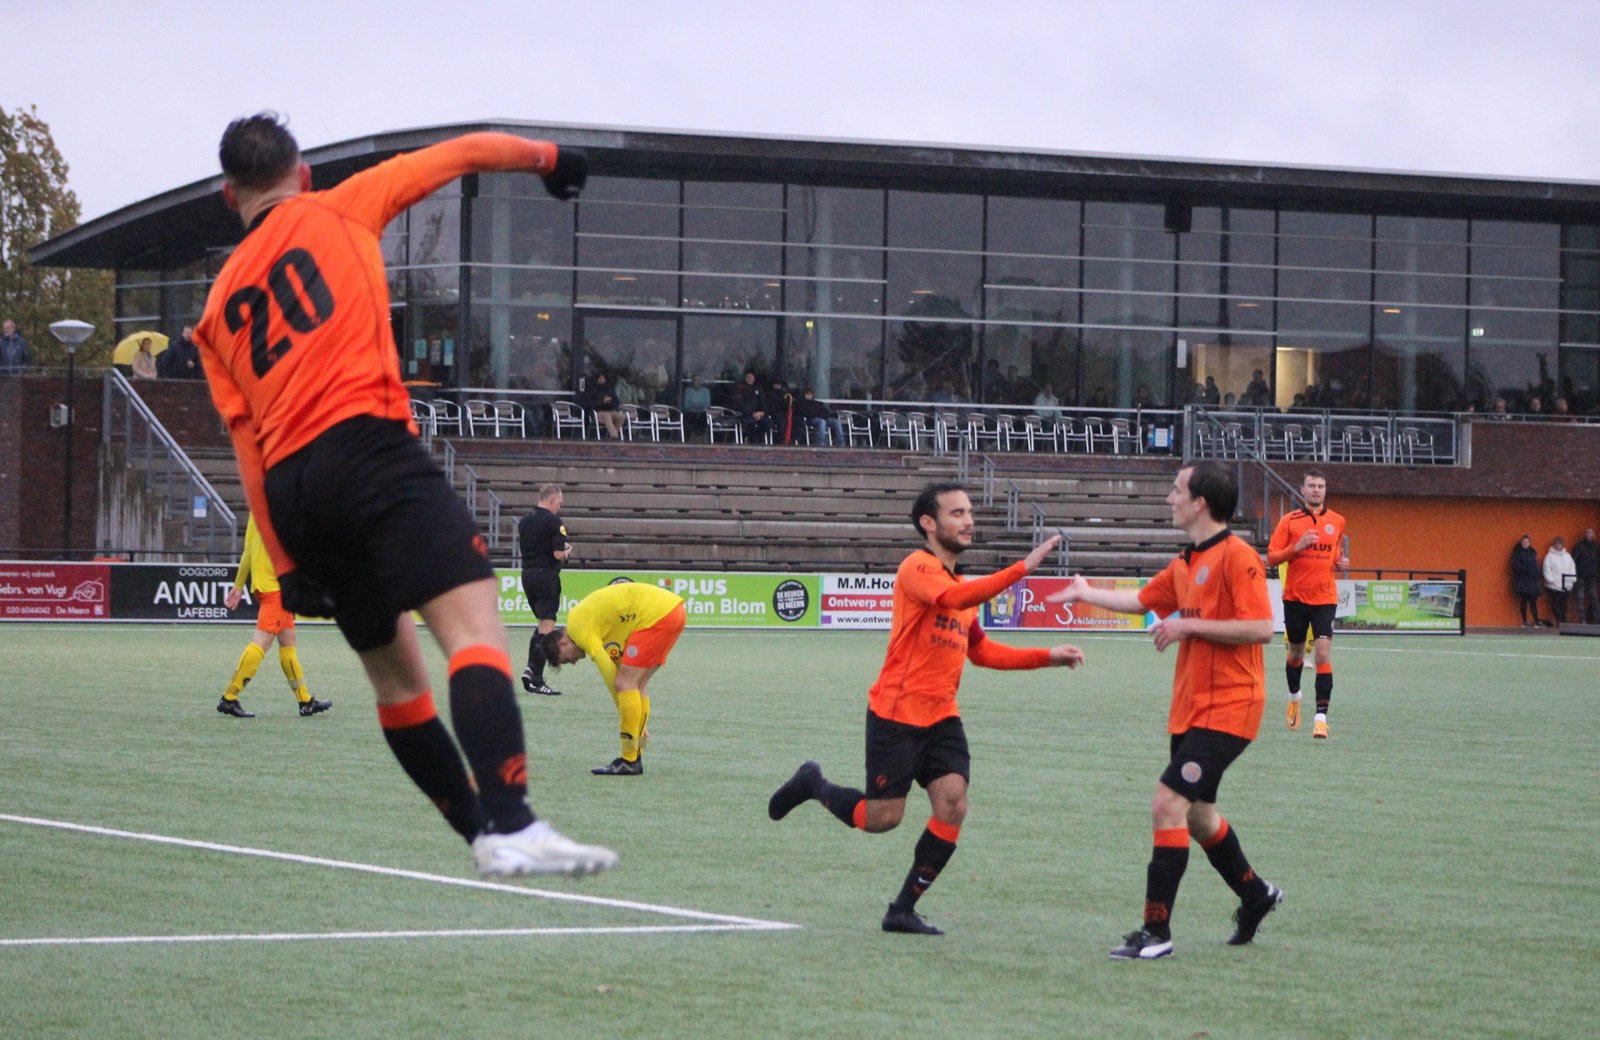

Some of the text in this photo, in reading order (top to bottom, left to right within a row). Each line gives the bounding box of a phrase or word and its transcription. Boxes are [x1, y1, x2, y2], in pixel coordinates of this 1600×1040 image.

[224, 247, 336, 380] 20
[179, 567, 228, 577] OOGZORG
[26, 586, 44, 595] van
[45, 583, 68, 598] Vugt
[501, 575, 526, 593] PL
[674, 578, 728, 595] PLUS
[153, 580, 253, 606] ANNITA
[1020, 588, 1046, 613] Peek
[497, 595, 533, 612] tefa
[720, 598, 766, 615] Blom
[828, 596, 877, 610] Ontwerp
[177, 607, 228, 618] LAFEBER
[1055, 602, 1132, 625] Schilderwerken
